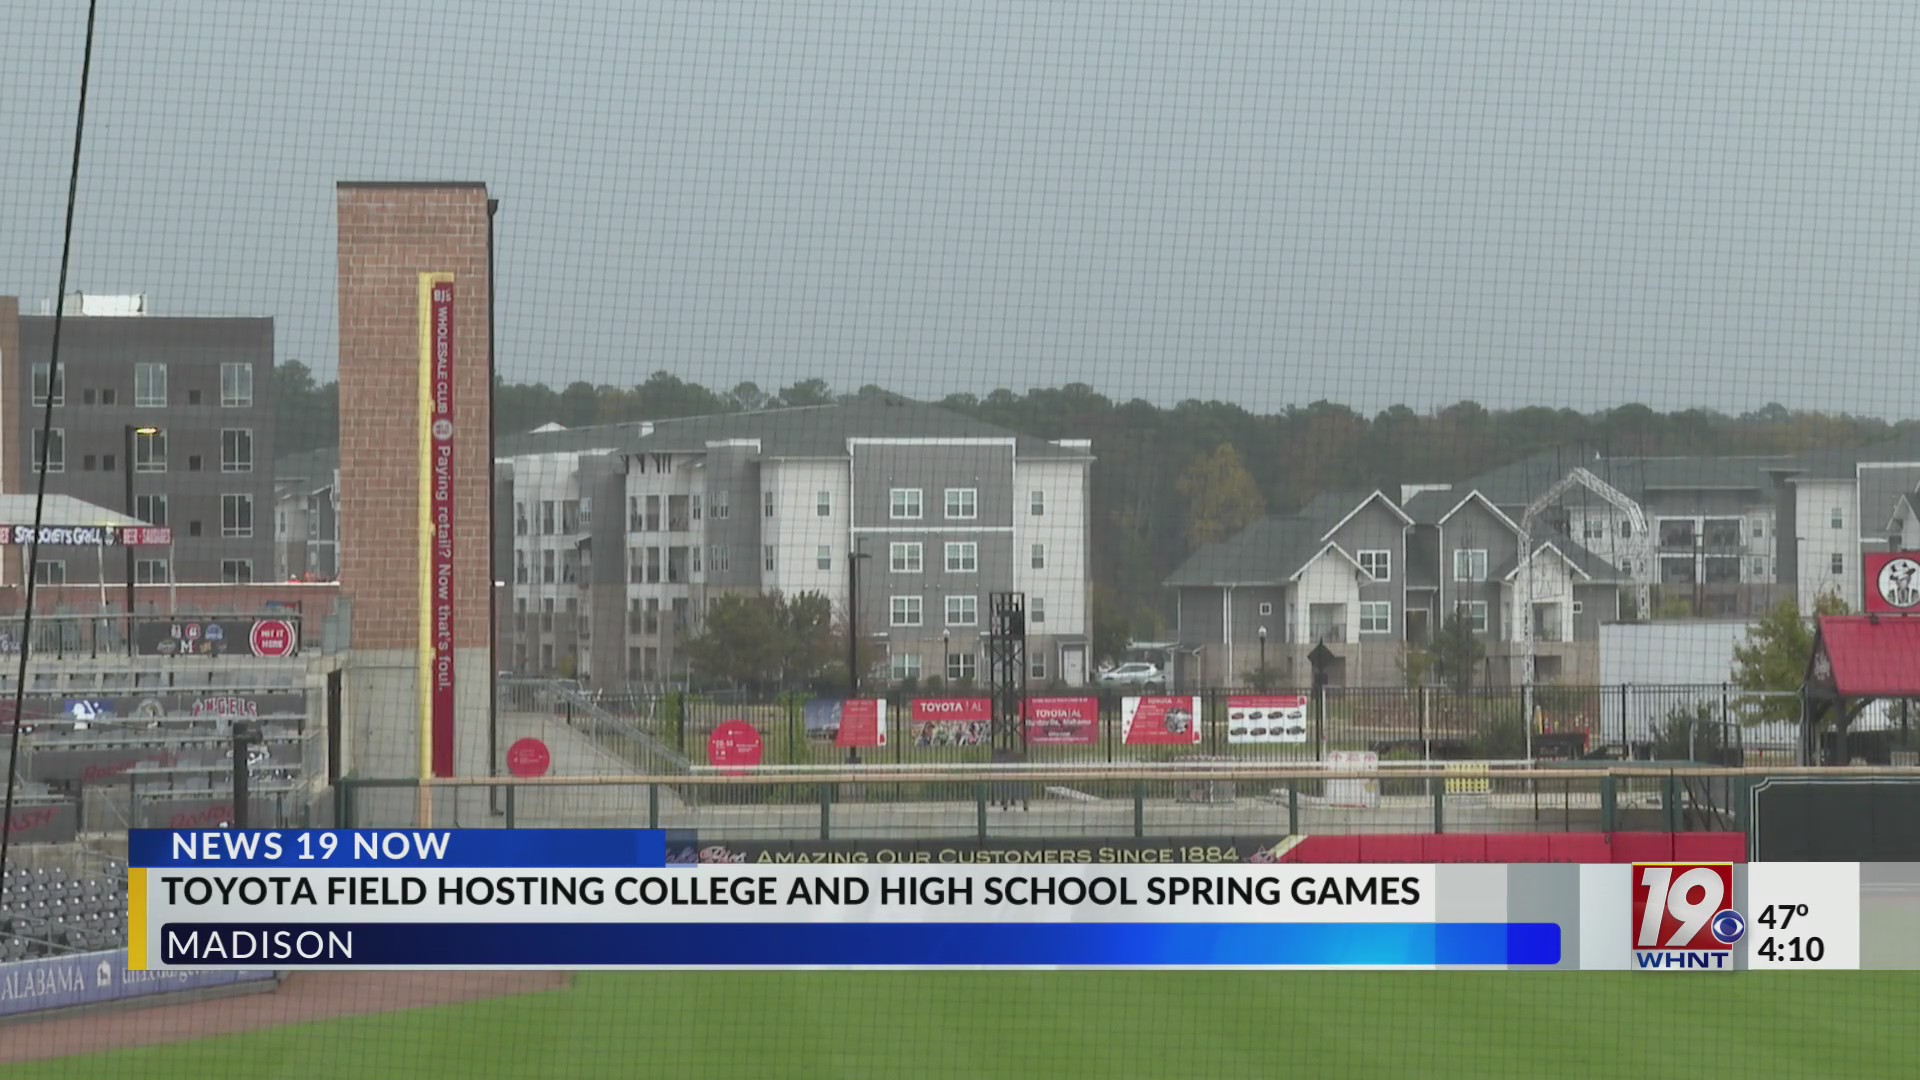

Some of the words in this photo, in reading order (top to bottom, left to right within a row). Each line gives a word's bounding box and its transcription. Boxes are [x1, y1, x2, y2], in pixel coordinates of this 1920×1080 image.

[437, 307, 448, 379] WHOLESALE
[437, 384, 448, 414] CLUB
[436, 446, 451, 500] Paying
[438, 507, 451, 559] retail?
[438, 564, 450, 600] Now
[438, 606, 451, 650] that's
[438, 656, 450, 691] foul.
[920, 702, 963, 712] TOYOTA
[1035, 709, 1067, 718] TOYOTA
[757, 849, 869, 863] AMAZING
[876, 849, 931, 863] OUR
[938, 849, 1093, 863] CUSTOMERS
[1099, 847, 1174, 863] SINCE
[1180, 846, 1239, 863] 1884
[1, 966, 85, 1000] ALABAMA
